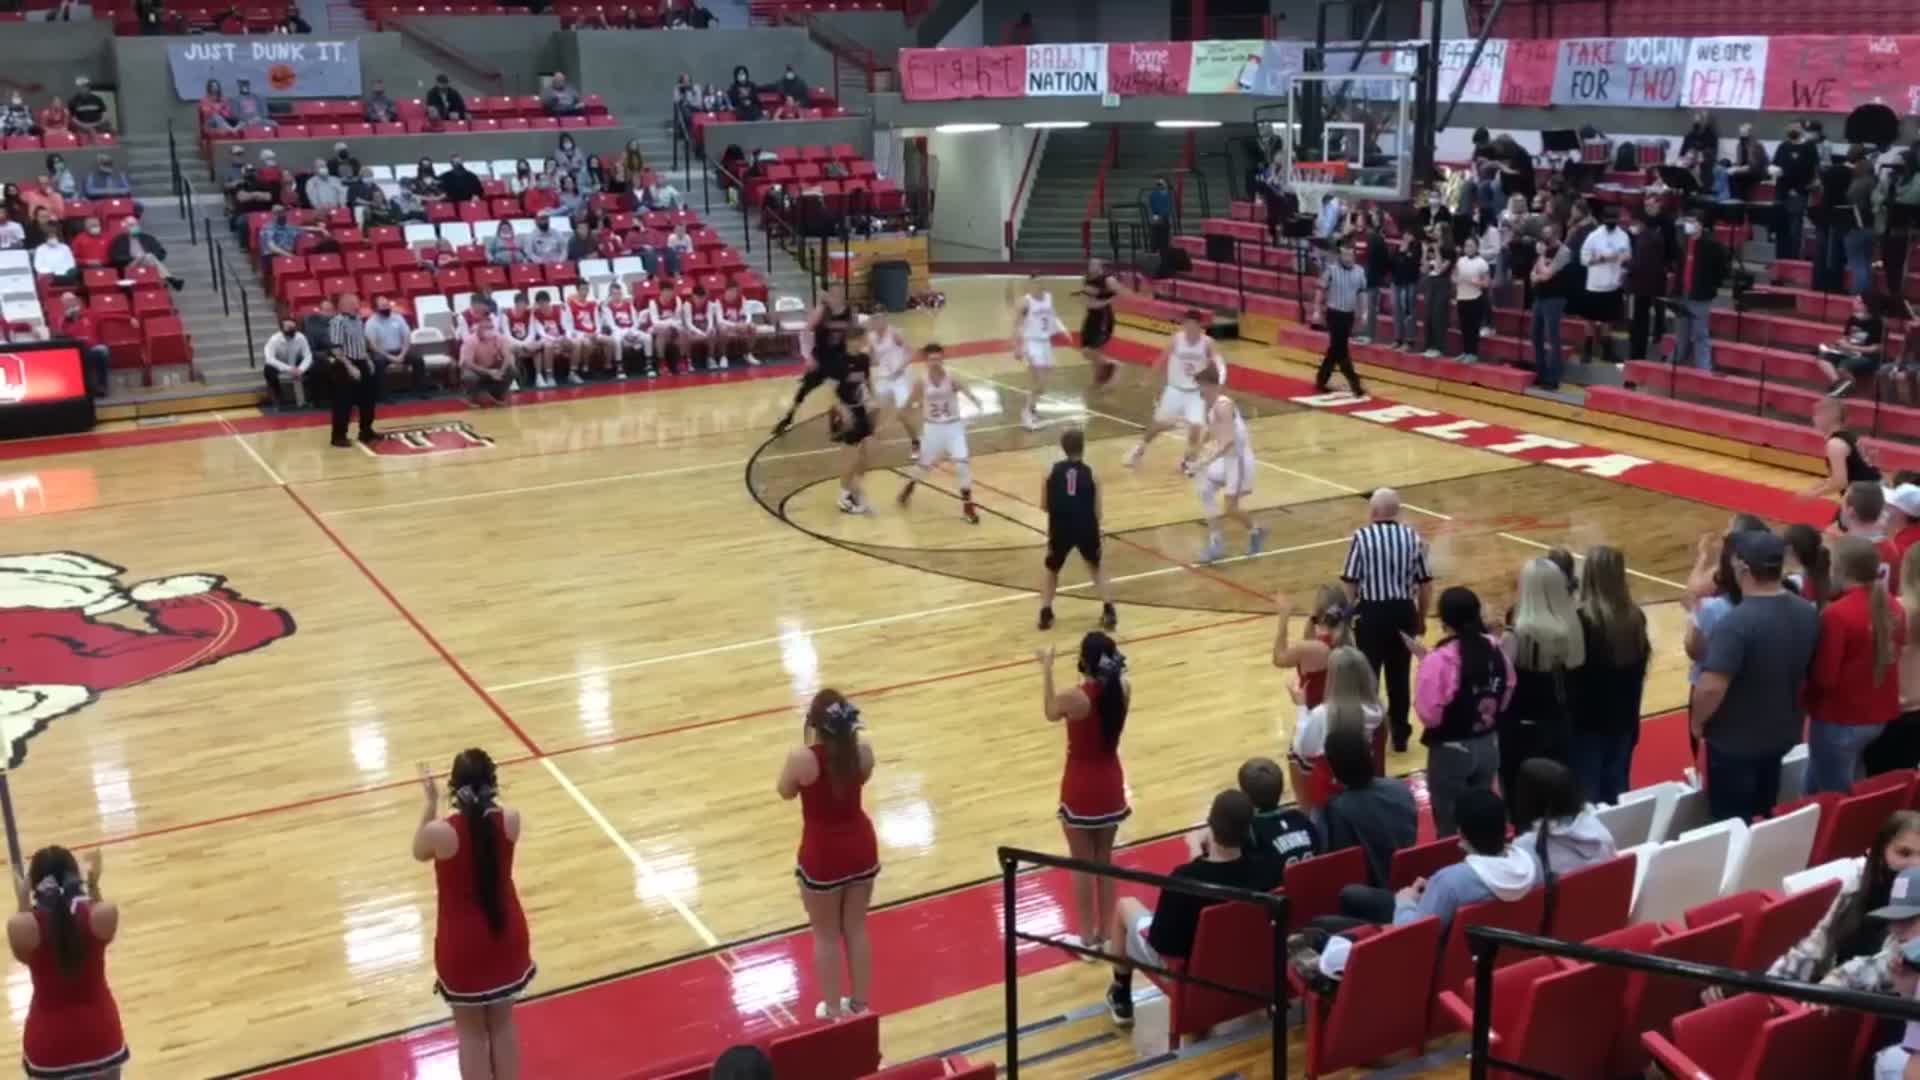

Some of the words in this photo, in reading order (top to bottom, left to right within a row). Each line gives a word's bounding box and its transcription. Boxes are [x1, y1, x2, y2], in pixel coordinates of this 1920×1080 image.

[184, 42, 237, 63] JUST
[252, 41, 304, 62] DUNK
[1566, 41, 1617, 66] TAKE
[1625, 38, 1685, 64] DOWN
[1029, 71, 1098, 92] NATION
[1570, 68, 1610, 100] FOR
[1626, 66, 1677, 101] TWO
[1690, 66, 1757, 106] DELTA
[1792, 77, 1838, 109] WE
[1288, 391, 1654, 478] DELTA
[1065, 467, 1078, 497] 1
